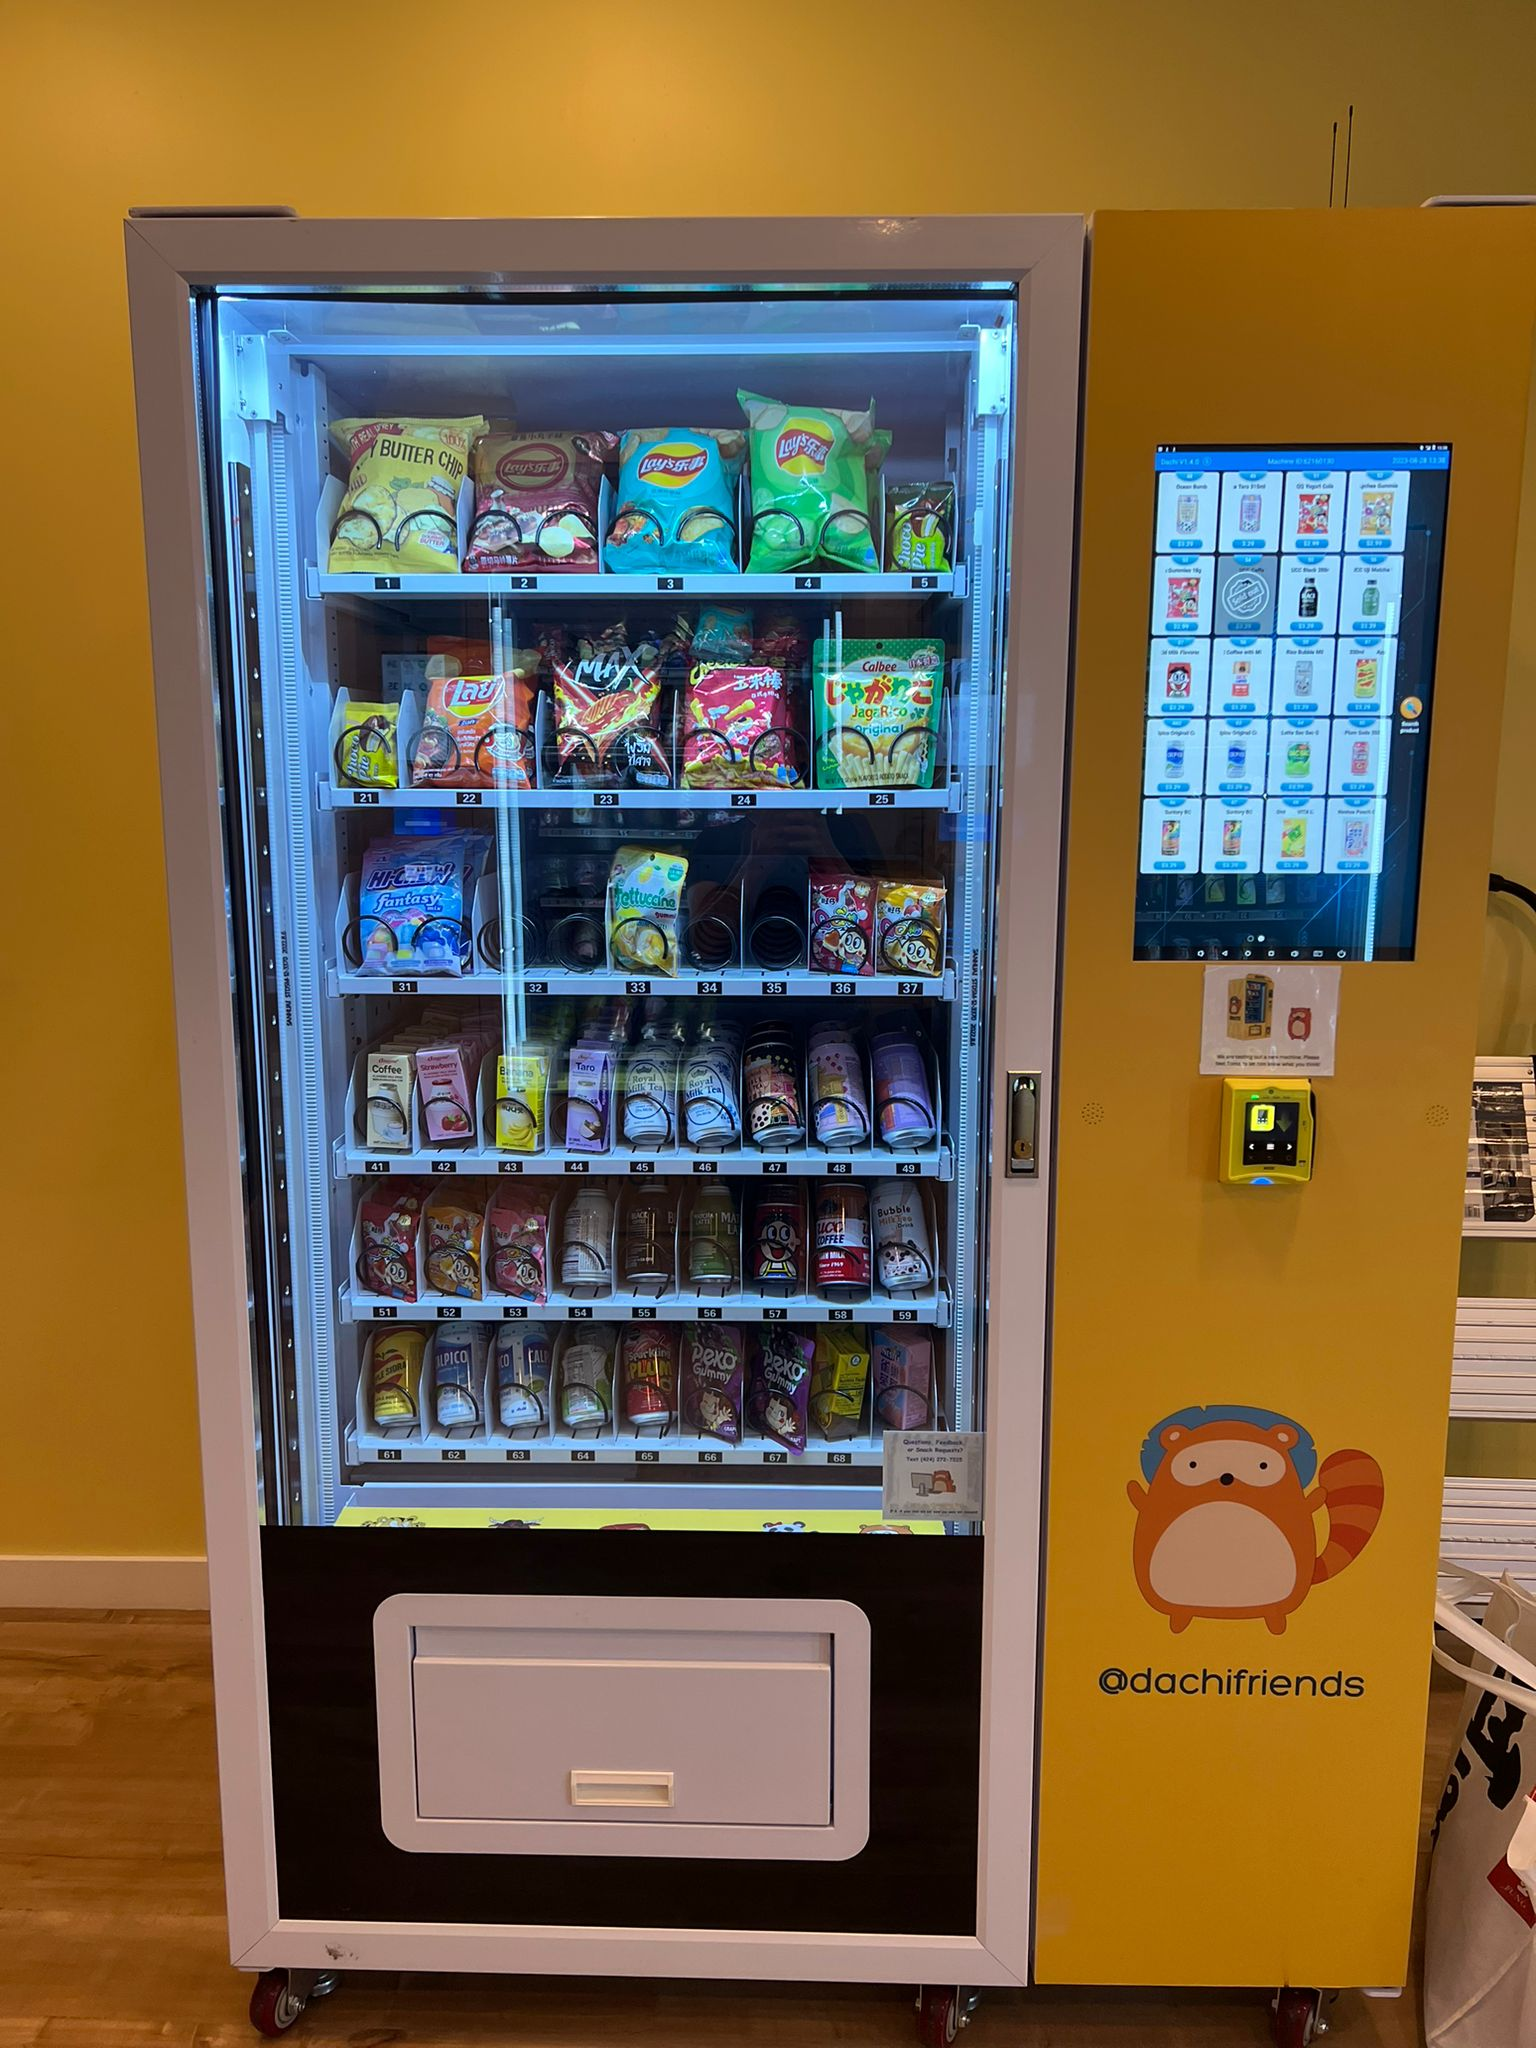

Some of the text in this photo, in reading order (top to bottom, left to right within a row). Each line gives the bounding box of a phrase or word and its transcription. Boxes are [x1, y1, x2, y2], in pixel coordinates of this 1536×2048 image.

[778, 432, 809, 459] Lay's
[380, 438, 435, 465] BUTTER
[438, 450, 465, 481] CHIP
[639, 458, 675, 474] Lay's
[384, 578, 391, 589] 1
[520, 577, 528, 588] 2
[667, 578, 674, 589] 3
[804, 578, 812, 588] 4
[921, 577, 929, 588] 5
[575, 647, 652, 691] MAX
[862, 661, 897, 673] Calbee
[359, 793, 372, 803] 21
[462, 793, 476, 803] 22
[599, 794, 613, 805] 23
[737, 795, 751, 805] 24
[875, 794, 889, 804] 25
[373, 892, 443, 914] fantasy
[398, 982, 411, 992] 31
[529, 983, 542, 993] 32
[630, 982, 646, 993] 33
[702, 982, 718, 993] 34
[766, 982, 782, 994] 35
[835, 982, 851, 994] 36
[902, 982, 918, 994] 37
[372, 1065, 402, 1075] Coffee
[420, 1062, 458, 1072] Strawberry
[575, 1062, 596, 1073] Taro
[632, 1073, 656, 1084] Royal
[688, 1075, 714, 1089] Royal
[650, 1082, 663, 1093] Tea
[685, 1085, 722, 1099] Milk Tea
[371, 1162, 383, 1171] 41
[437, 1162, 451, 1171] 42
[504, 1162, 517, 1172] 43
[570, 1162, 583, 1171] 44
[636, 1163, 649, 1172] 45
[698, 1162, 712, 1172] 46
[768, 1163, 781, 1172] 47
[833, 1164, 846, 1173] 48
[902, 1164, 915, 1173] 49
[877, 1204, 912, 1218] Bubble
[817, 1234, 845, 1246] COFFEE
[379, 1308, 391, 1317] 51
[443, 1308, 456, 1317] 52
[509, 1308, 522, 1317] 53
[574, 1308, 587, 1317] 54
[638, 1308, 651, 1318] 55
[703, 1309, 717, 1318] 56
[769, 1309, 781, 1318] 57
[834, 1310, 848, 1320] 58
[899, 1311, 912, 1320] 59
[692, 1362, 732, 1385] Gummy
[764, 1366, 798, 1396] Gummy
[383, 1450, 395, 1459] 61
[447, 1450, 460, 1459] 62
[512, 1451, 525, 1460] 63
[577, 1451, 589, 1460] 64
[641, 1452, 654, 1461] 65
[704, 1453, 717, 1462] 66
[769, 1453, 782, 1462] 67
[833, 1454, 846, 1463] 68
[1098, 1668, 1365, 1698] @dachifriends
